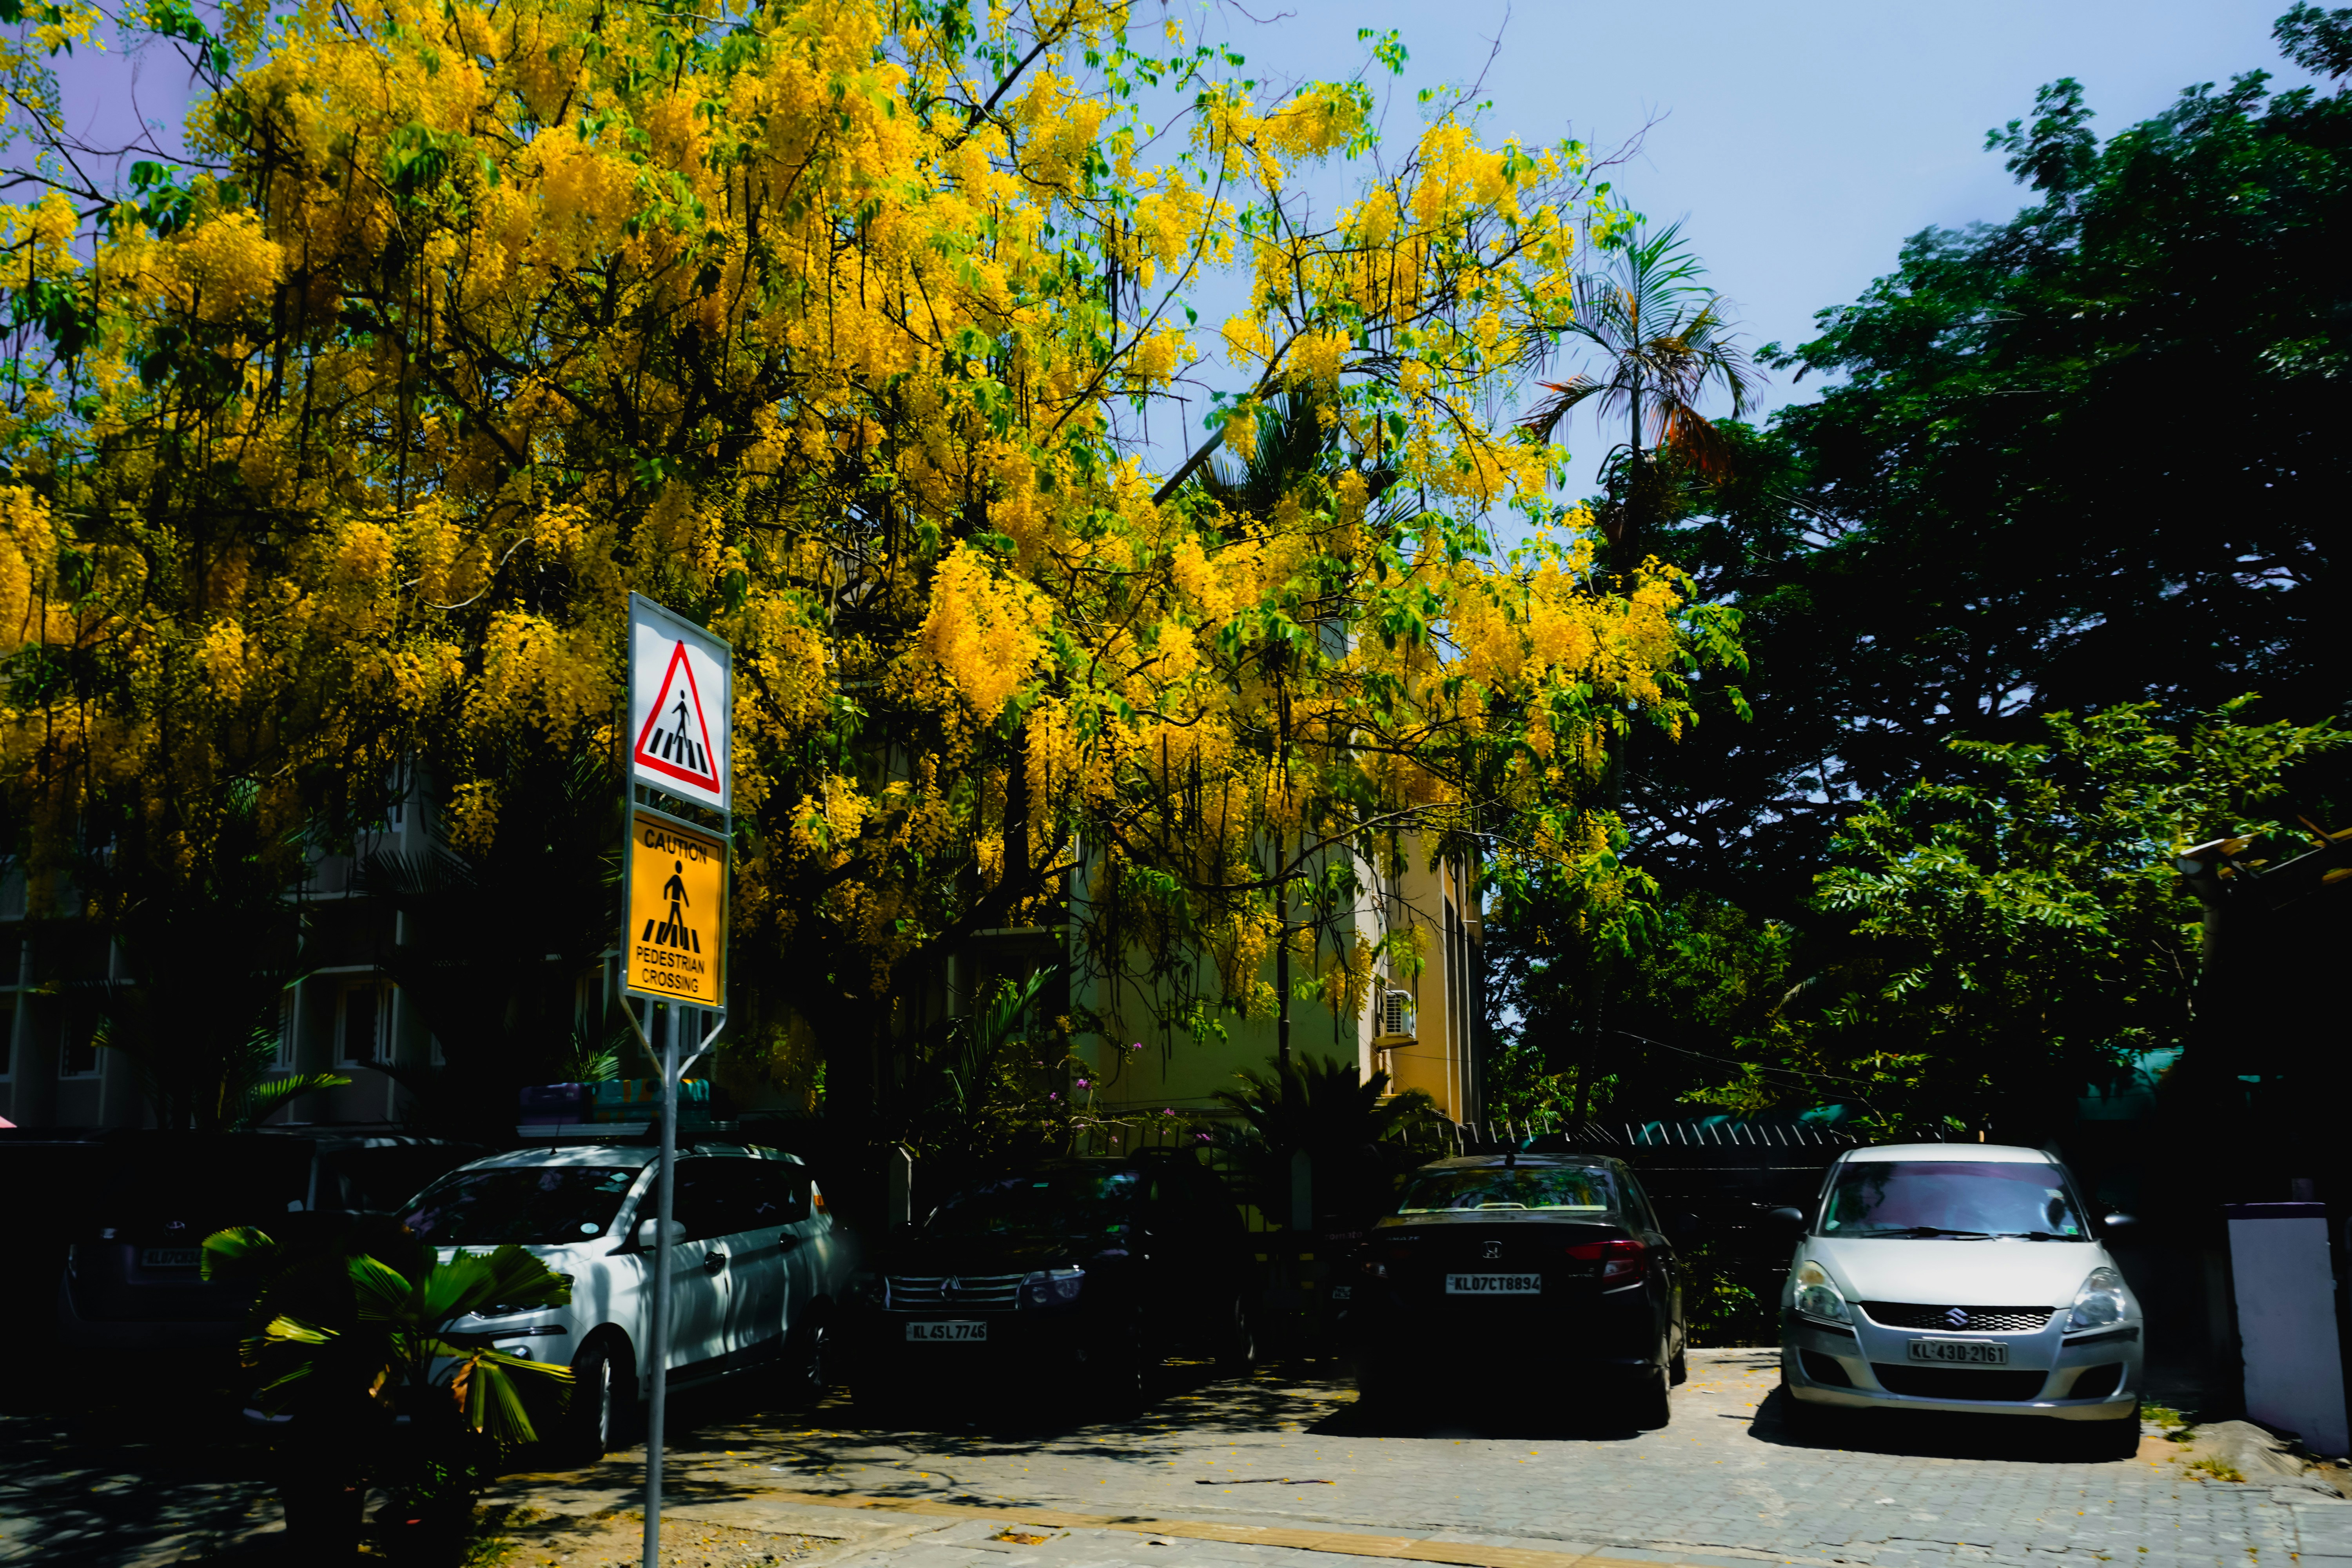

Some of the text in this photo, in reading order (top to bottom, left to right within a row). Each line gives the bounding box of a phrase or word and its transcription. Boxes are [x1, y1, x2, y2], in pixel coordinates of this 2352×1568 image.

[645, 829, 707, 864] CAUTION
[636, 946, 704, 974] PEDESTRIAN
[642, 968, 699, 993] CROSSING
[1455, 1277, 1539, 1290] KL07CT8894
